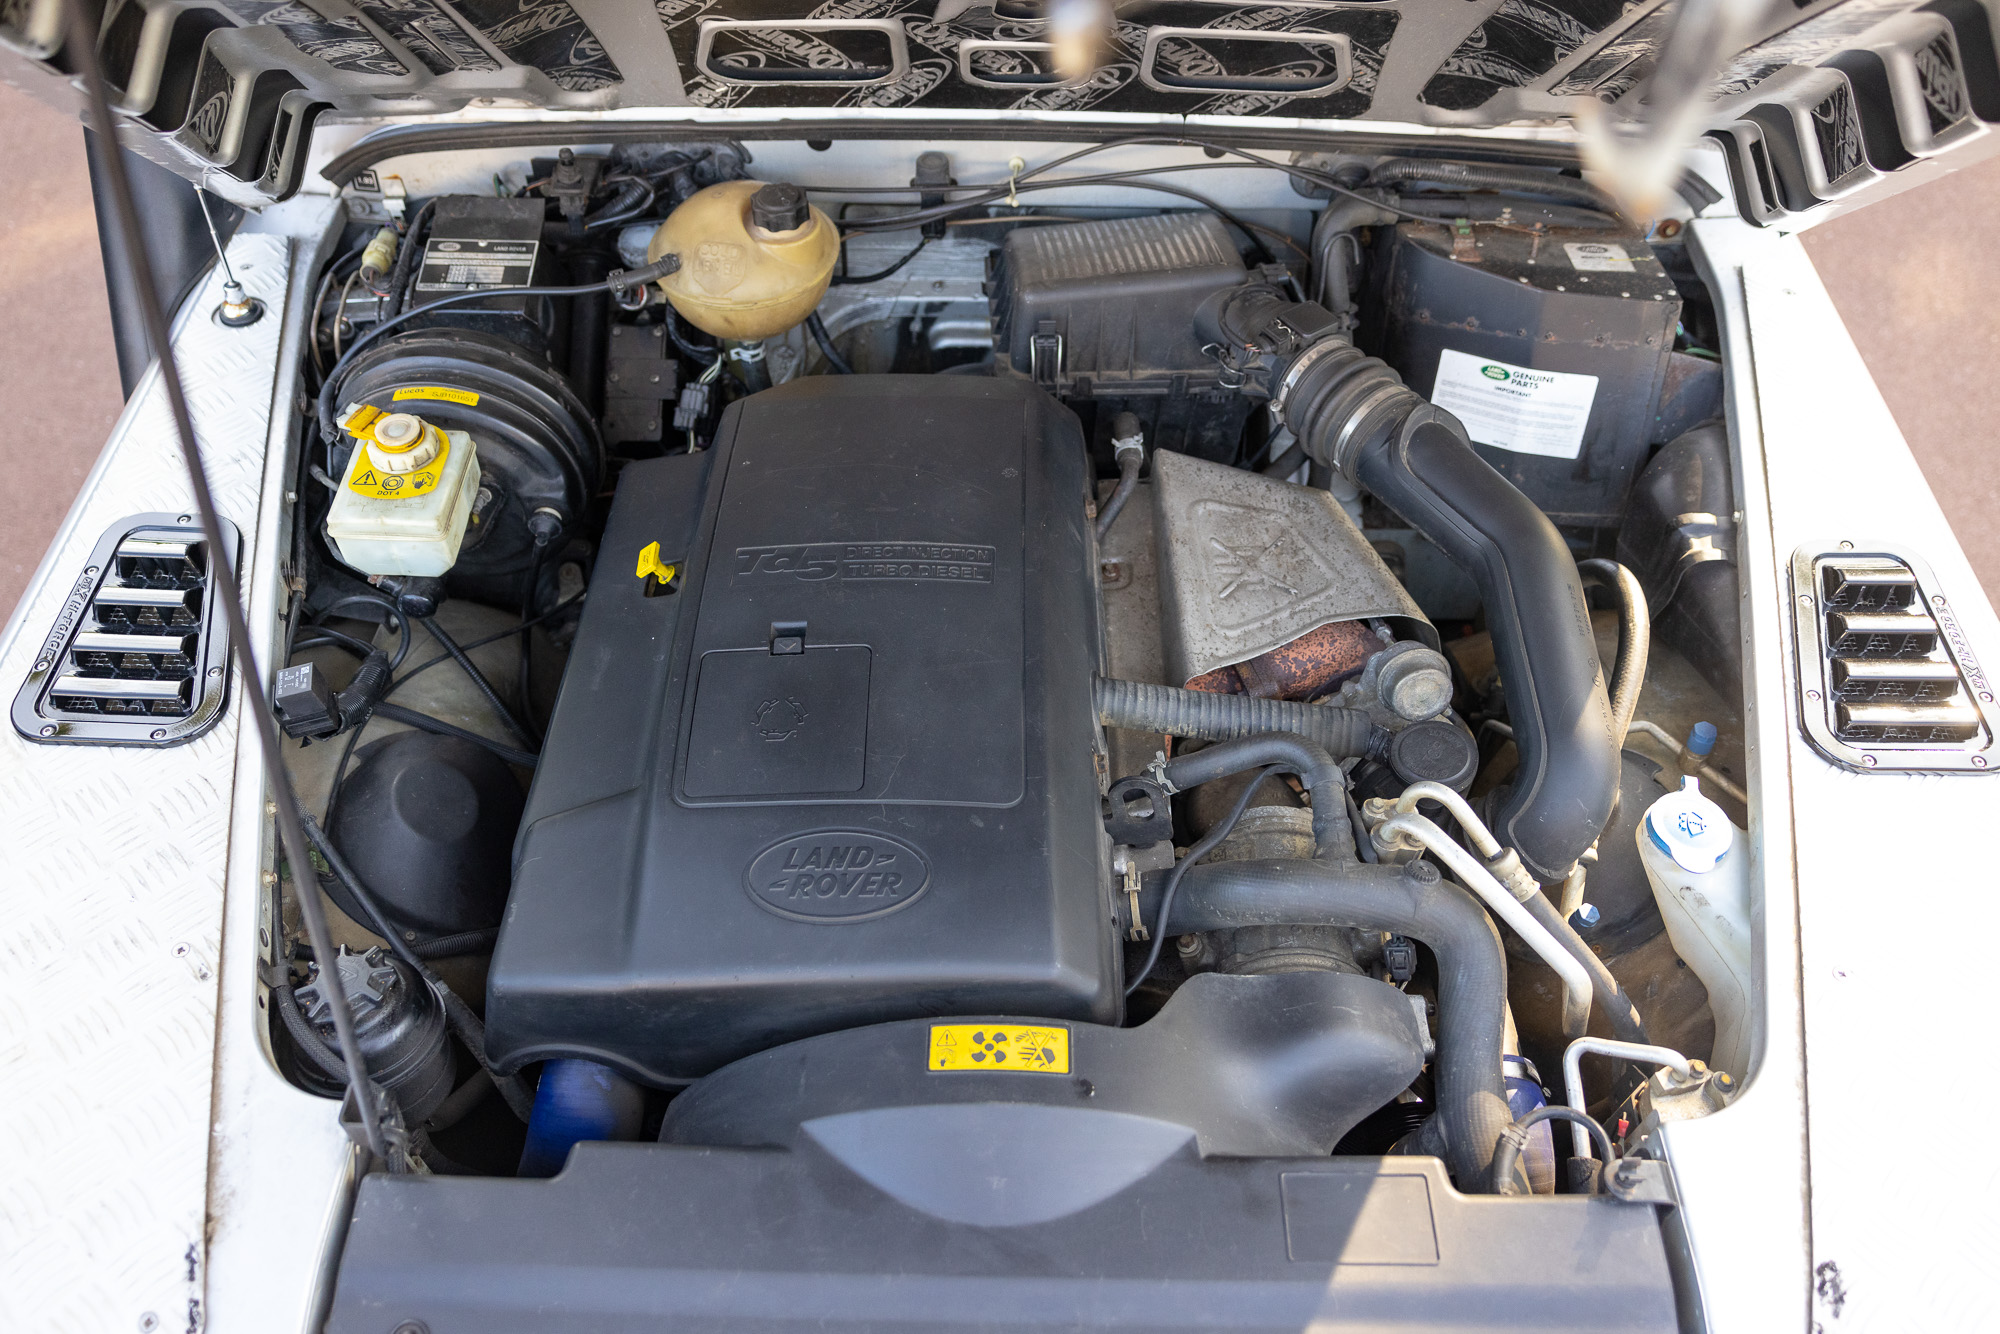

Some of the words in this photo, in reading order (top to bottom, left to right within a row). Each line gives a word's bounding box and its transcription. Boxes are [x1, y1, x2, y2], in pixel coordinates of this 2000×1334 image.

[1510, 378, 1539, 389] PARTS
[1512, 371, 1555, 383] GENUINE
[1494, 385, 1532, 397] IMPORTANT
[846, 546, 901, 559] DIRECT
[905, 547, 989, 561] INJECTION
[849, 564, 912, 578] TURBO
[918, 565, 985, 579] DIESEL
[782, 846, 875, 872] LAND
[789, 872, 903, 899] ROVER
